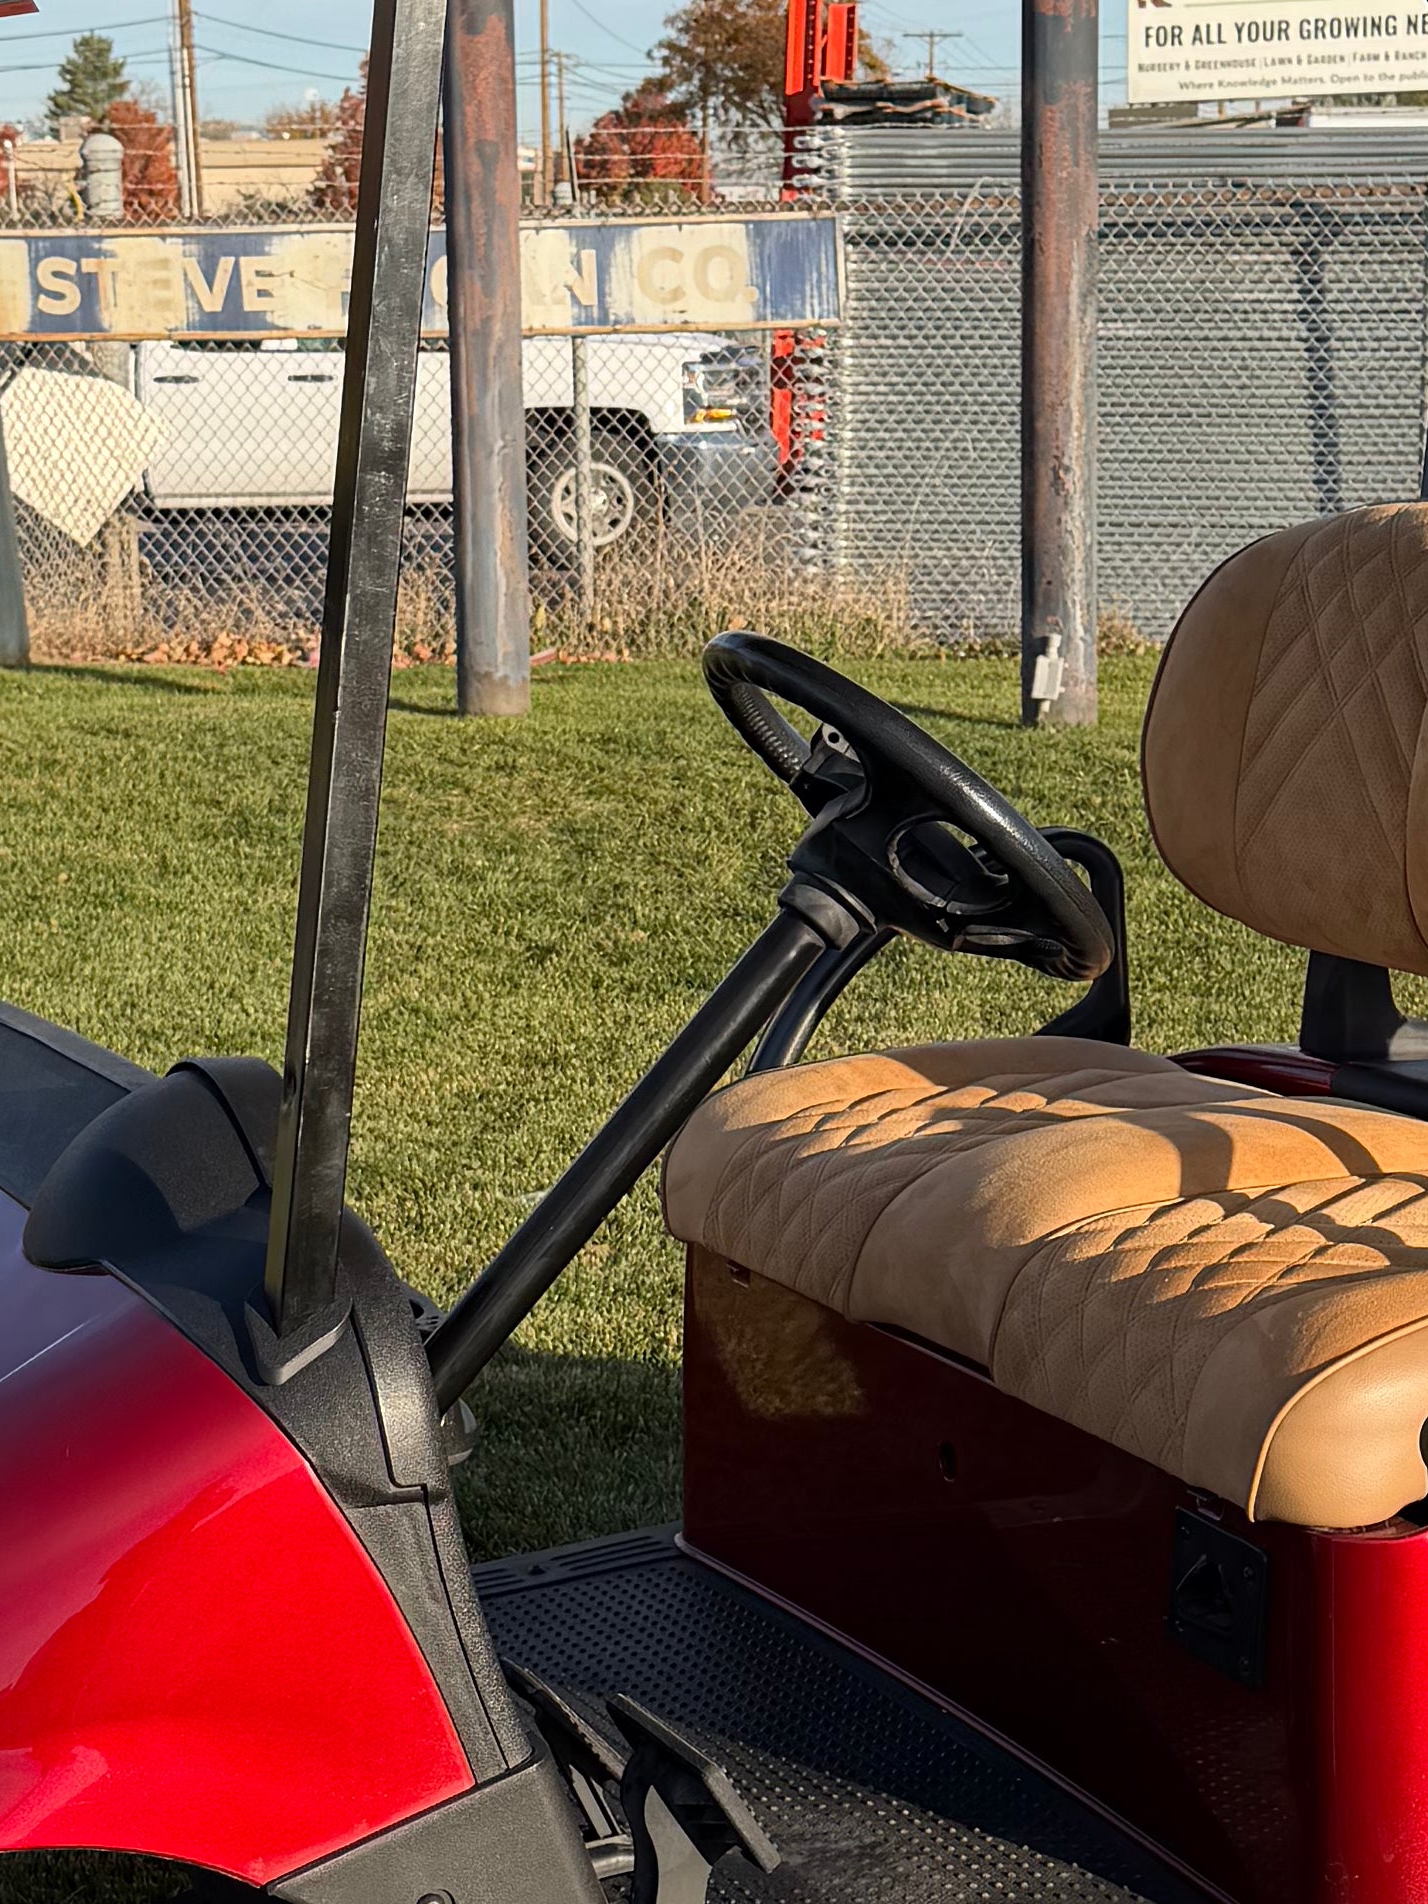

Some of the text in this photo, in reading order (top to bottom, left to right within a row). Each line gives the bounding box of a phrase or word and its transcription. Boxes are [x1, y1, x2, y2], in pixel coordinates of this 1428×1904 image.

[1145, 24, 1183, 48] FOR
[1192, 22, 1227, 45] ALL
[1234, 19, 1290, 44] YOUR
[1299, 14, 1398, 40] GROWING
[1195, 57, 1256, 70] GREENHOUSE
[1264, 55, 1293, 68] LAWN
[1307, 53, 1345, 65] GARDEN
[1352, 51, 1380, 63] FARM
[1178, 79, 1214, 91] Where
[1217, 75, 1278, 90] Knowledge
[1281, 75, 1325, 86] Matters.
[1330, 73, 1360, 85] Open
[1363, 72, 1375, 82] to
[1378, 71, 1396, 82] the
